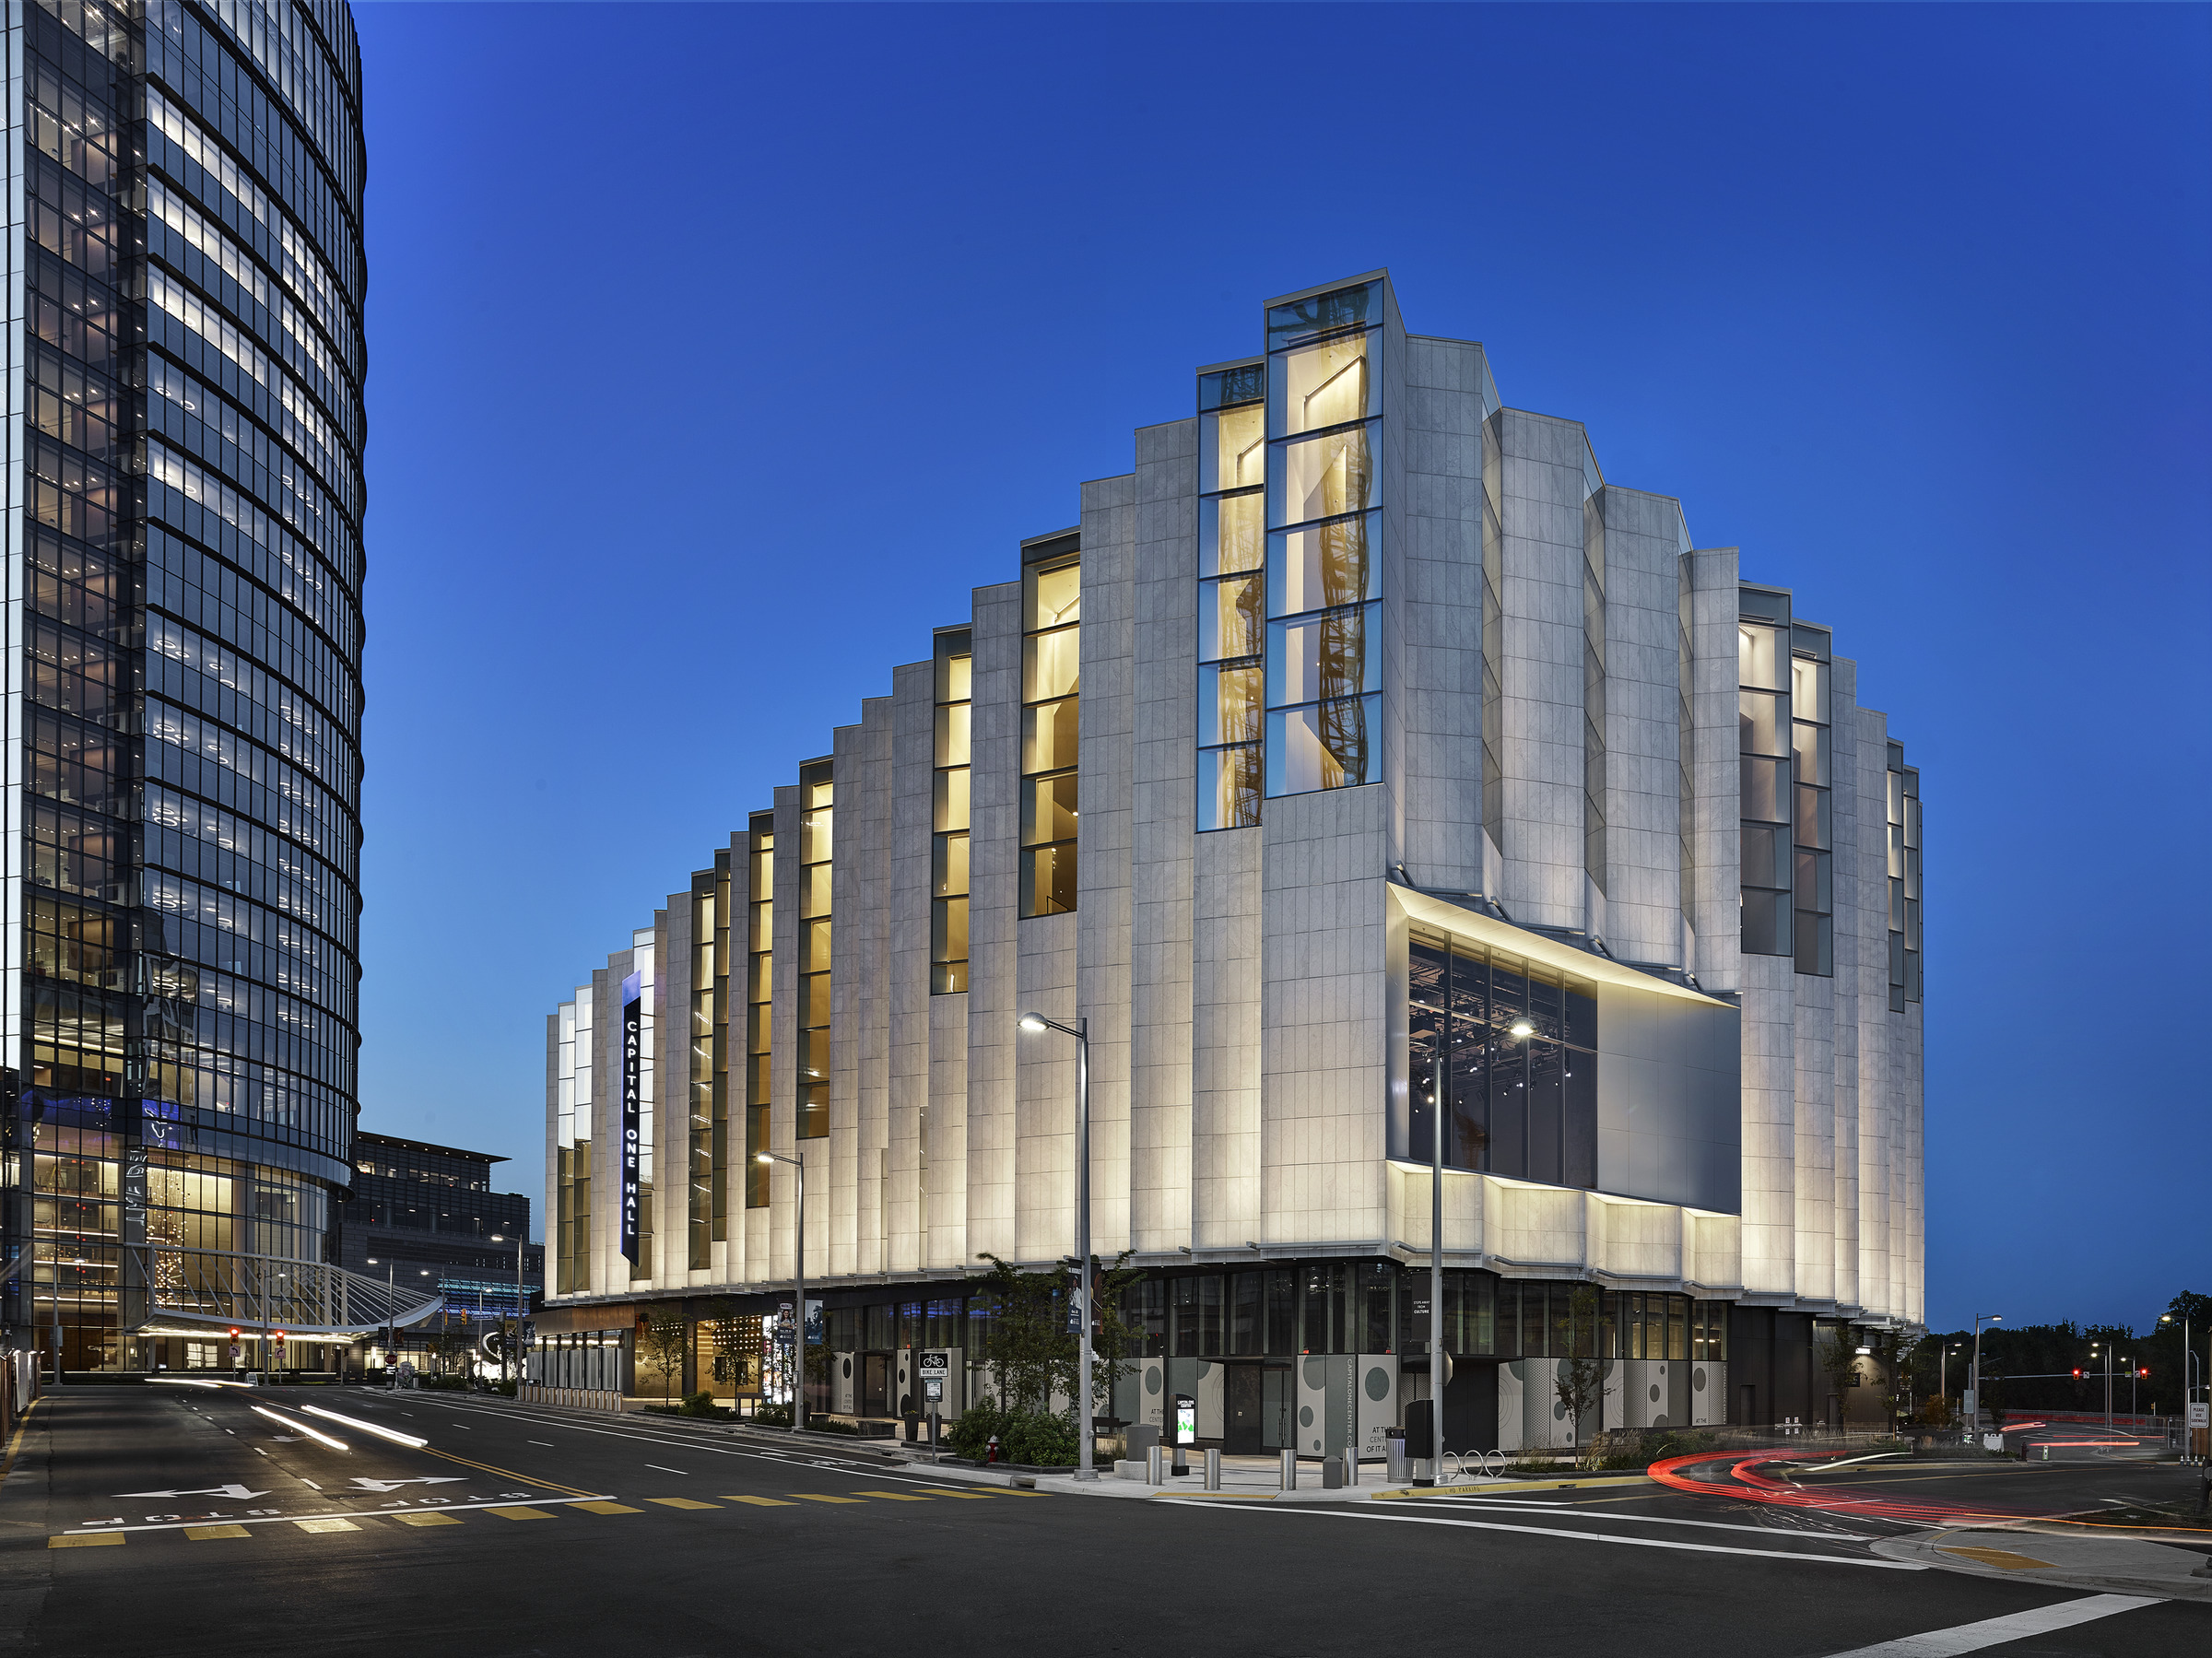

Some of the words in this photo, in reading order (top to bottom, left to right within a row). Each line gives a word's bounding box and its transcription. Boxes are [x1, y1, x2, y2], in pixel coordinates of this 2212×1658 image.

[627, 1020, 638, 1113] CAPITAL
[626, 1128, 638, 1169] ONE
[626, 1182, 637, 1236] HALL
